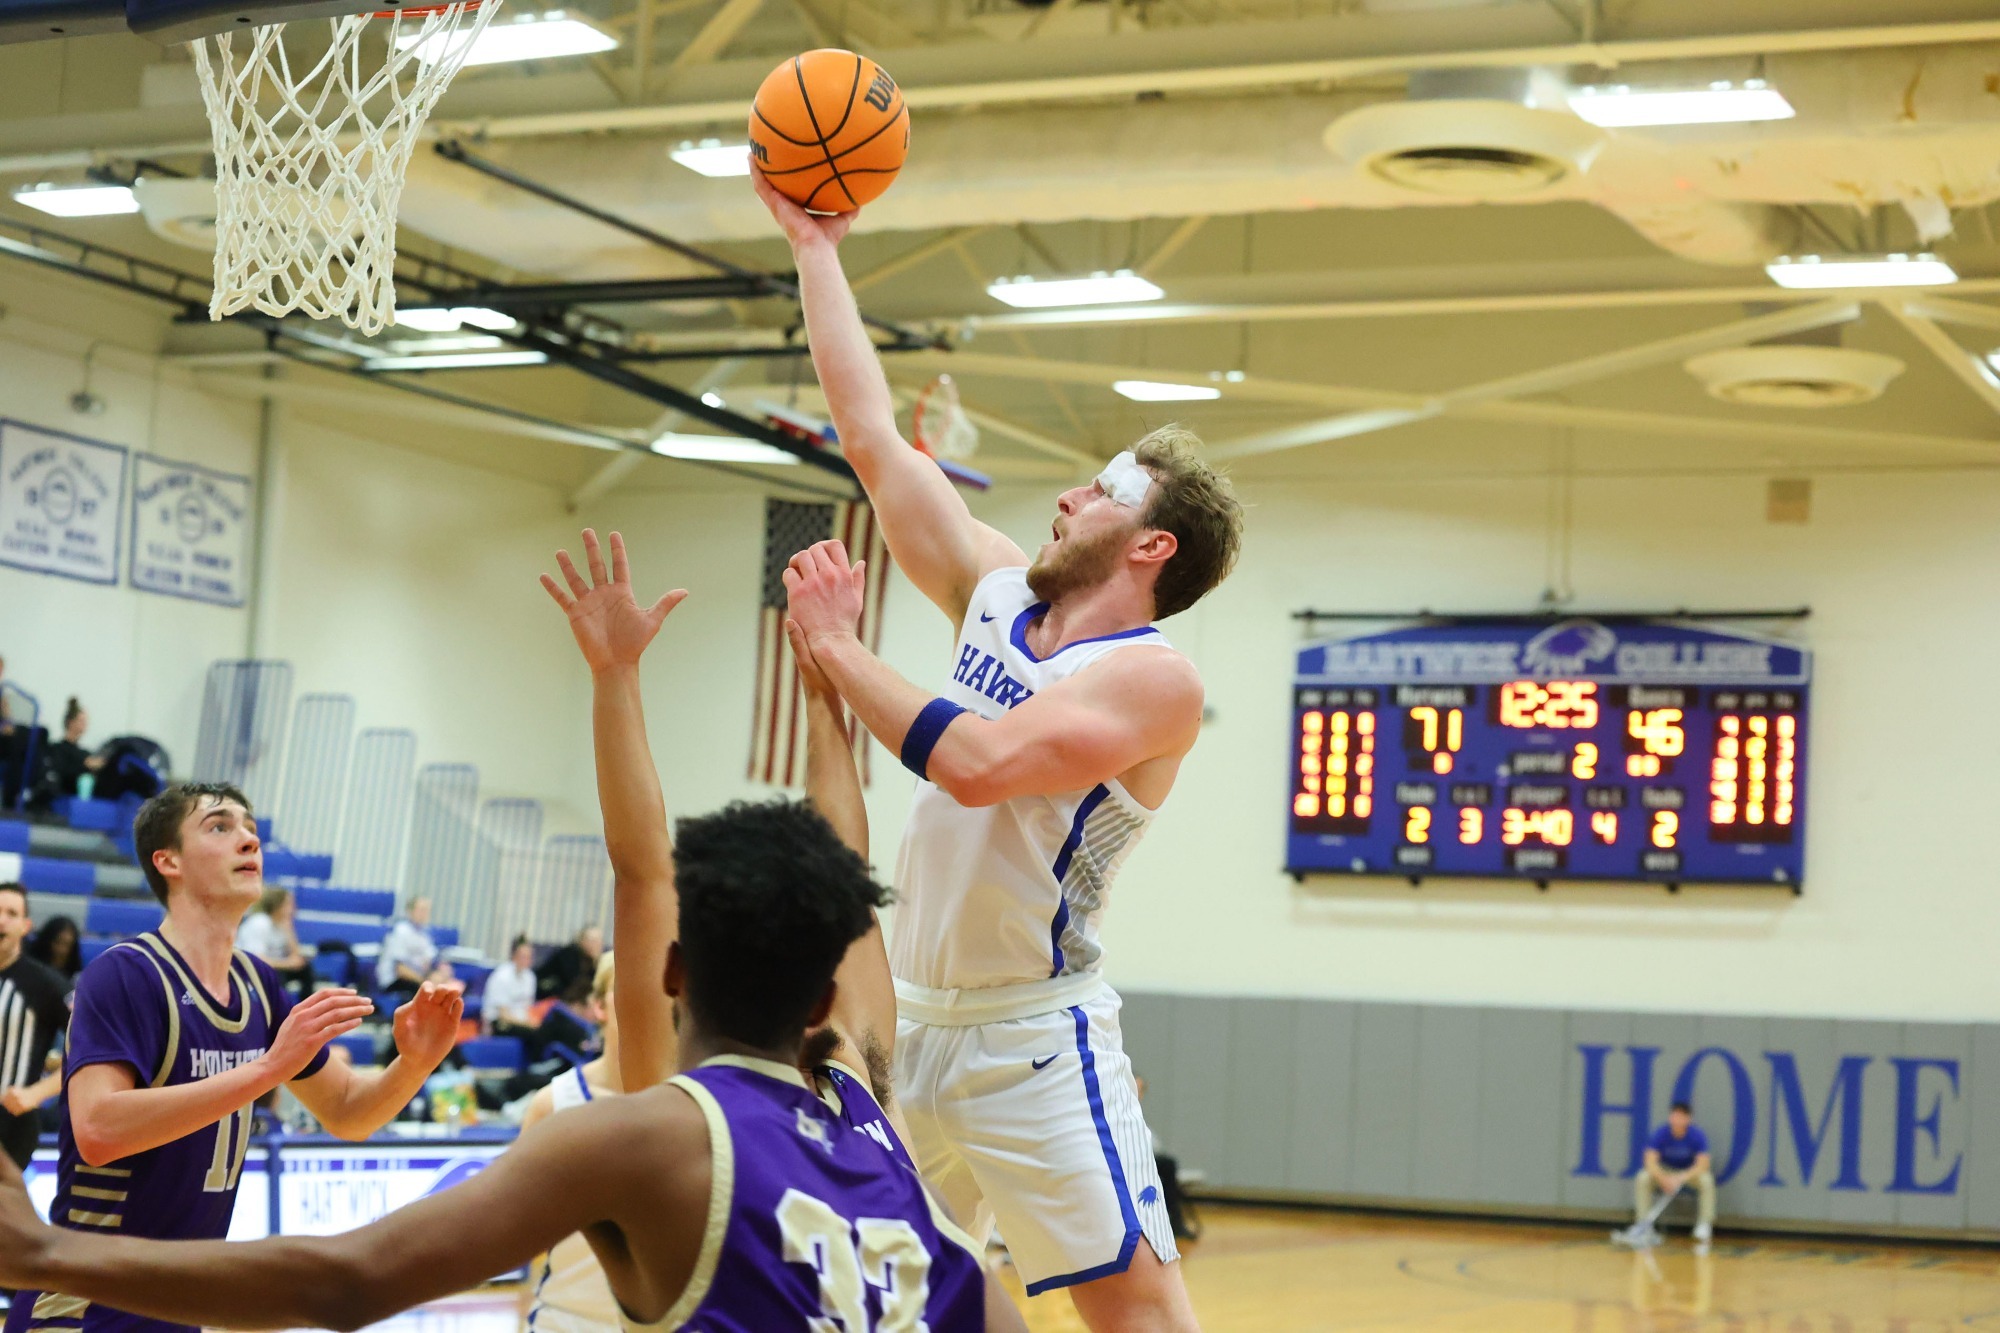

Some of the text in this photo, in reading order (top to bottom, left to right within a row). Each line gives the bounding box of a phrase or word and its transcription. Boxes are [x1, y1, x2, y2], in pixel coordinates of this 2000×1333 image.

[1501, 680, 1598, 728] 12:25
[1410, 706, 1463, 752] 71
[1628, 708, 1684, 757] 46
[1572, 742, 1598, 779] 2
[1406, 806, 1431, 843] 2
[1459, 807, 1483, 844] 3
[1591, 811, 1617, 845] 4
[1652, 810, 1679, 848] 2
[1571, 1043, 1962, 1195] HOME
